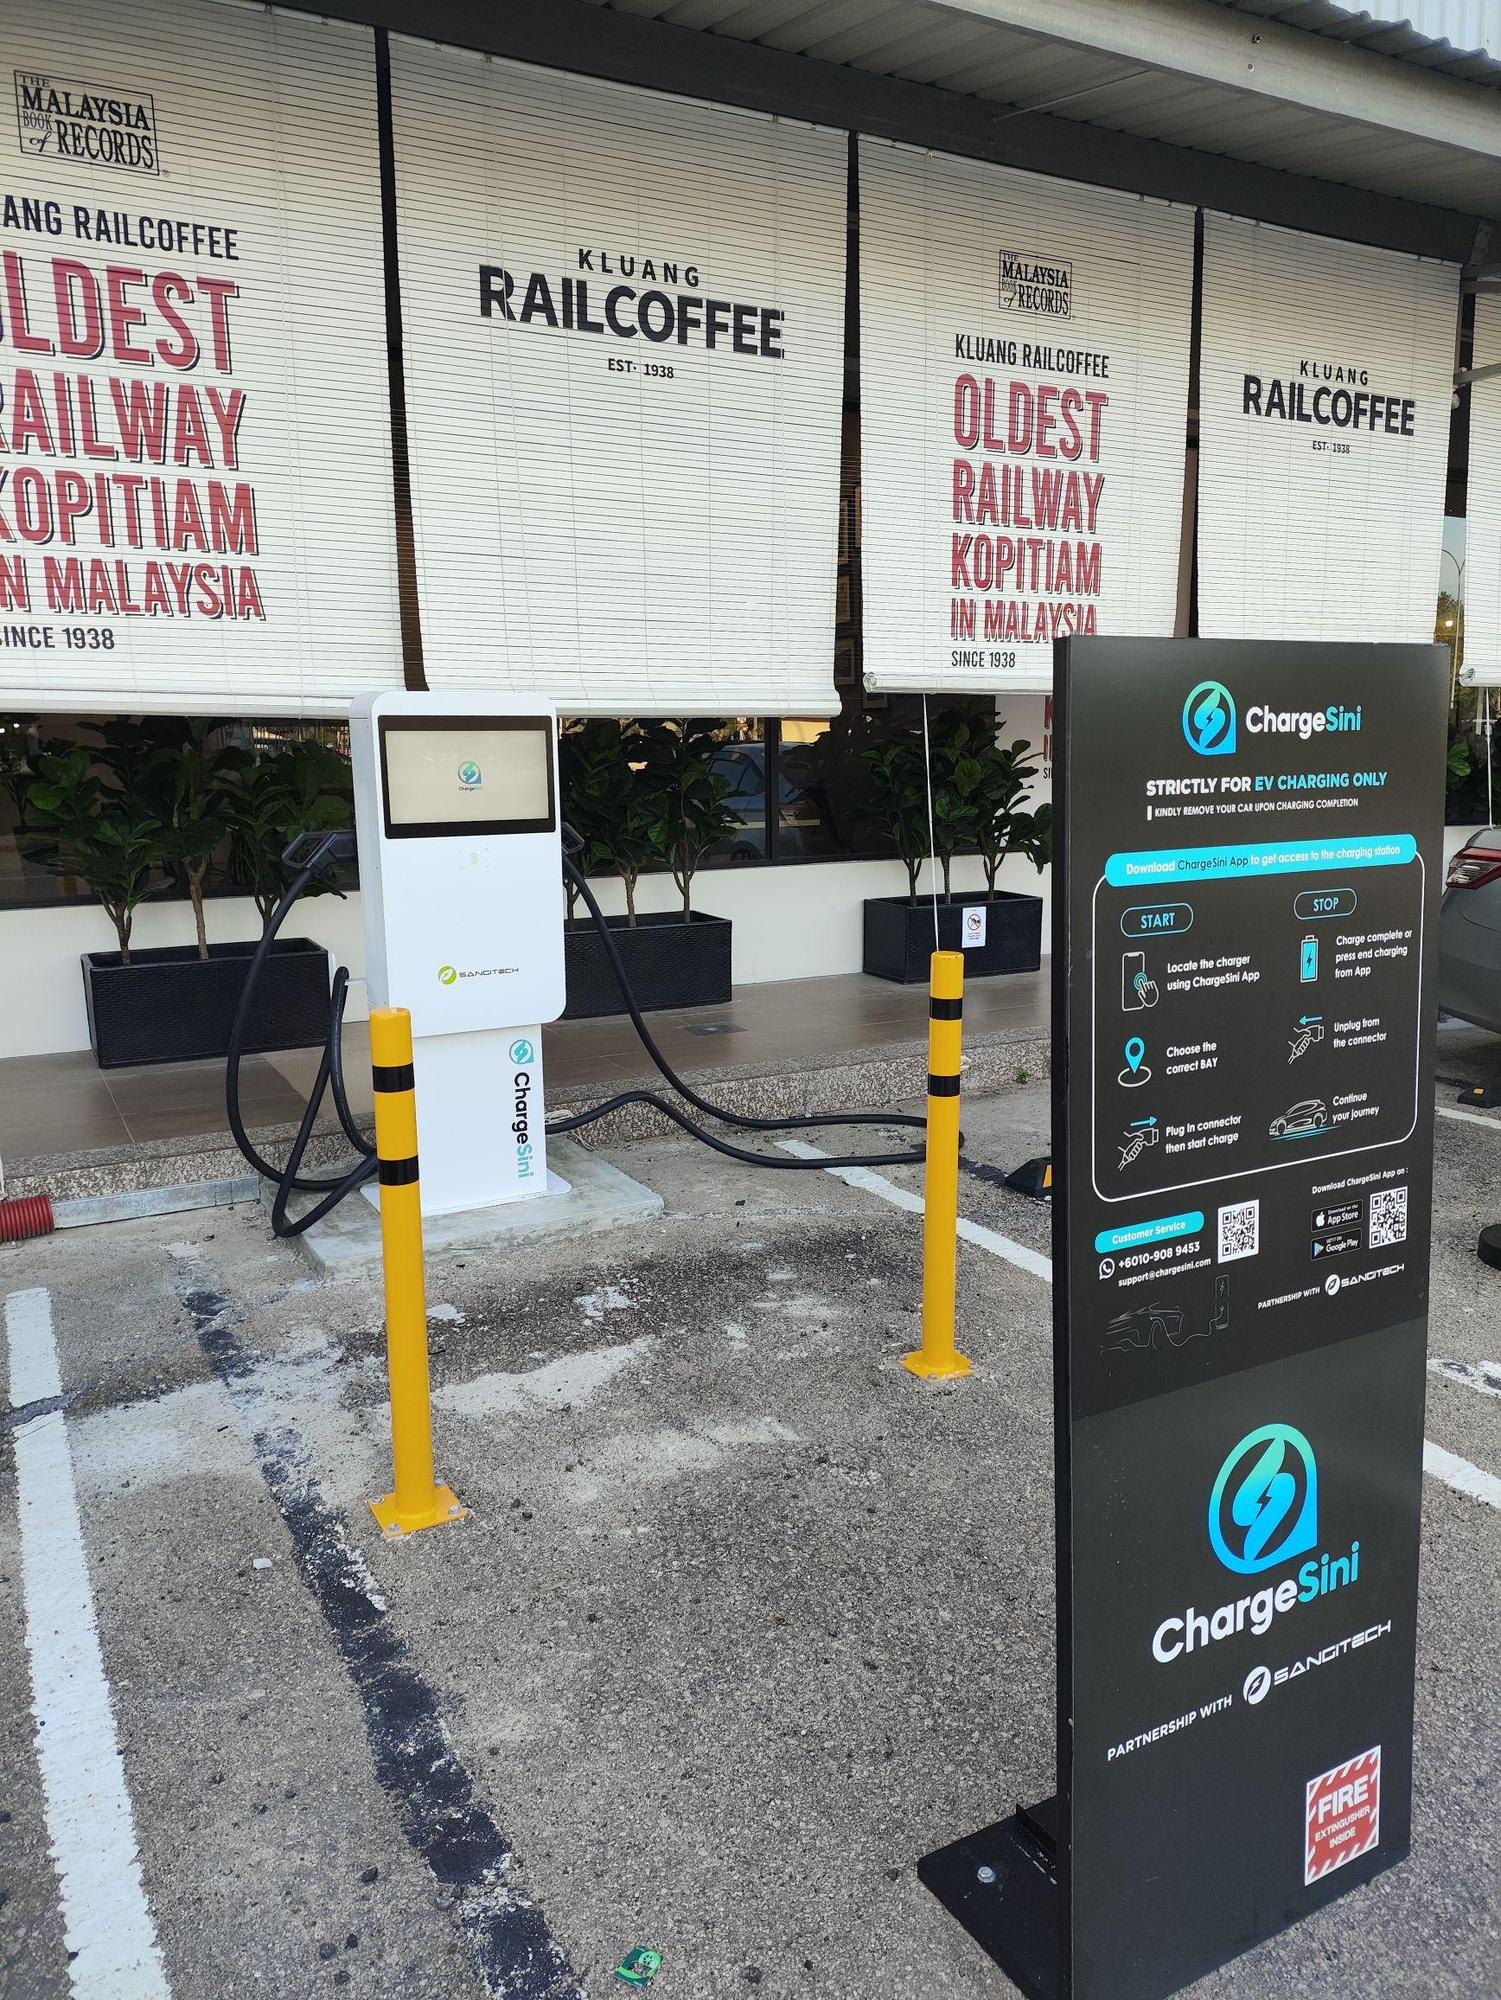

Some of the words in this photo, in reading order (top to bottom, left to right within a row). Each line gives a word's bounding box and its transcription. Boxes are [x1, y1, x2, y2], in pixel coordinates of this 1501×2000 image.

[19, 74, 50, 88] THE
[21, 85, 151, 131] MALAYSIA
[22, 110, 53, 131] BOOK
[29, 130, 52, 152] of
[56, 119, 155, 170] RECORDS
[2, 194, 62, 236] ANG
[73, 205, 239, 260] RAILCOFFEE
[578, 248, 699, 287] KLUANG
[1001, 252, 1018, 261] THE
[1001, 260, 1069, 288] MALAYSIA
[0, 250, 239, 374] LDEST
[479, 264, 785, 359] RAILCOFFEE
[1018, 284, 1069, 315] RECORDS
[955, 333, 1017, 366] KLUANG
[1023, 343, 1109, 378] RAILCOFFEE
[643, 363, 674, 379] 1938
[1300, 359, 1369, 386] KLUANG
[1243, 374, 1415, 436] RAILCOFFEE
[0, 368, 246, 470] AILWAY
[953, 372, 1109, 464] OLDEST
[1332, 443, 1350, 454] 1938
[952, 458, 1105, 534] RAILWAY
[951, 532, 1103, 596] KOPITIAM
[43, 555, 266, 621] MALAYSIA
[950, 597, 976, 641] IN
[984, 599, 1097, 643] MALAYSIA
[0, 625, 54, 649] INCE
[62, 627, 115, 650] 1938
[951, 650, 985, 668] SINCE
[988, 651, 1016, 668] 1938
[1245, 705, 1362, 740] ChargeSini
[1146, 777, 1218, 796] STRICTLY
[1221, 776, 1251, 793] FOR
[1254, 775, 1274, 791] EV
[1277, 773, 1349, 790] CHARGING
[1353, 771, 1388, 787] ONLY
[1154, 805, 1182, 817] KINDLY
[1183, 804, 1214, 816] REMOVE
[1216, 803, 1236, 814] YOUR
[1238, 802, 1253, 813] CAR
[1254, 801, 1275, 812] UPON
[1276, 799, 1314, 811] CHARGING
[1316, 797, 1359, 809] COMPLETION
[1126, 860, 1175, 875] Download
[1178, 857, 1228, 870] ChargeSini
[1229, 856, 1248, 868] App
[1250, 855, 1260, 865] to
[1261, 854, 1276, 867] get
[1278, 853, 1308, 862] access
[1310, 850, 1320, 860] to
[1321, 849, 1335, 859] the
[1336, 847, 1373, 858] charging
[1374, 845, 1400, 856] station
[1313, 897, 1339, 912] STOP
[1140, 912, 1176, 929] START
[1336, 933, 1366, 948] Charge
[1367, 928, 1403, 945] complete
[1404, 929, 1413, 939] or
[1167, 959, 1198, 974] Locate
[1199, 957, 1214, 970] the
[1216, 954, 1251, 969] charger
[1335, 951, 1356, 965] press
[1357, 948, 1373, 960] end
[1374, 945, 1408, 959] charging
[1166, 978, 1191, 992] using
[1192, 972, 1240, 988] ChargeSini
[1242, 970, 1261, 984] App
[1334, 967, 1353, 979] from
[1355, 965, 1371, 978] App
[1333, 1019, 1361, 1034] Unplug
[1362, 1016, 1380, 1029] from
[1166, 1042, 1201, 1058] Choose
[1202, 1040, 1217, 1053] the
[1333, 1037, 1346, 1049] the
[1347, 1031, 1387, 1047] connector
[1166, 1059, 1199, 1075] correct
[1200, 1056, 1219, 1070] BAY
[1332, 1091, 1368, 1107] Continue
[511, 1072, 534, 1178] ChargeSini
[1165, 1124, 1186, 1138] Plug
[1197, 1114, 1242, 1132] connector
[1332, 1111, 1350, 1125] your
[1350, 1105, 1380, 1121] journey
[1165, 1142, 1186, 1155] then
[1187, 1136, 1207, 1150] start
[1207, 1132, 1239, 1147] charge
[1311, 1178, 1346, 1195] Download
[1346, 1171, 1381, 1188] ChargeSini
[1382, 1169, 1396, 1181] App
[1396, 1167, 1406, 1176] on
[1327, 1215, 1341, 1226] App
[1341, 1211, 1359, 1222] Store
[1111, 1227, 1153, 1245] Customer
[1155, 1219, 1187, 1235] Service
[1118, 1247, 1174, 1270] +6010-908
[1175, 1240, 1201, 1257] 9453
[1326, 1241, 1347, 1253] Google
[1347, 1238, 1359, 1248] Play
[1118, 1257, 1212, 1288] support@chargesini.com
[1257, 1291, 1302, 1310] PARTNERSHIP
[1303, 1286, 1321, 1298] WITH
[1152, 1540, 1360, 1664] ChargeSini
[1106, 1710, 1197, 1762] PARTNERSHIP
[1199, 1694, 1233, 1720] WITH
[1318, 1774, 1369, 1824] FIRE
[1329, 1826, 1357, 1849] INSIDE
